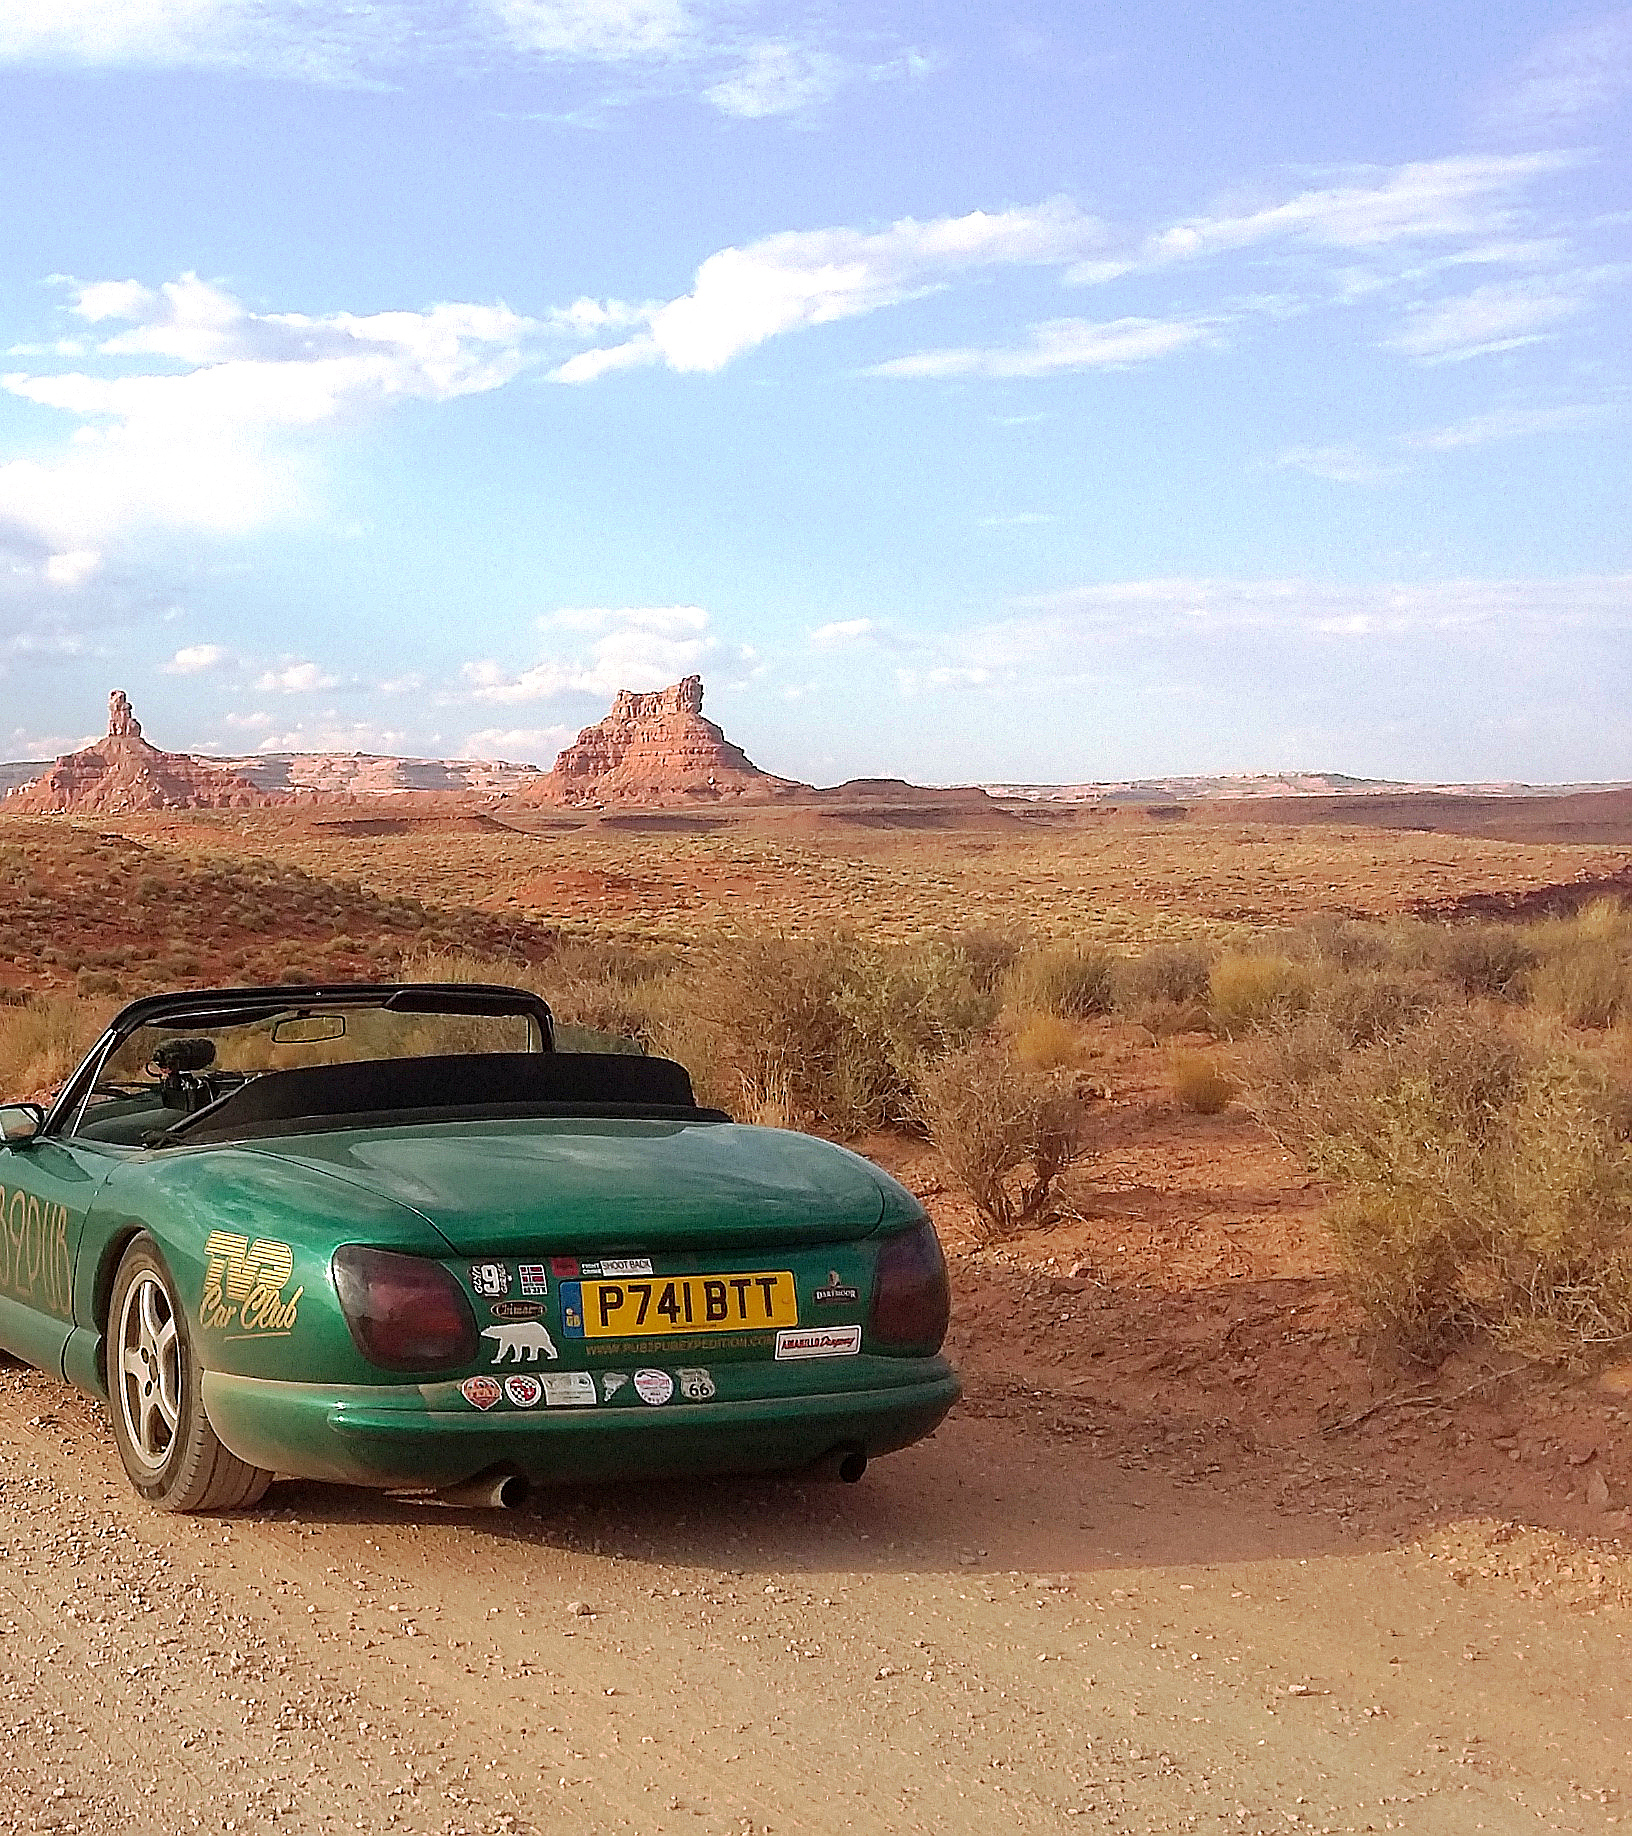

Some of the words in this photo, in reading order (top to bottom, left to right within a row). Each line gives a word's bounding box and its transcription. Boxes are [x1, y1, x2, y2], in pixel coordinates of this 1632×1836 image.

[204, 1230, 293, 1302] TVR
[602, 1260, 629, 1271] SHOOT
[629, 1259, 651, 1269] BACK
[199, 1284, 237, 1329] Car
[240, 1284, 304, 1329] Club
[598, 1281, 693, 1328] P741
[703, 1276, 778, 1322] BTT
[688, 1382, 710, 1397] 66
